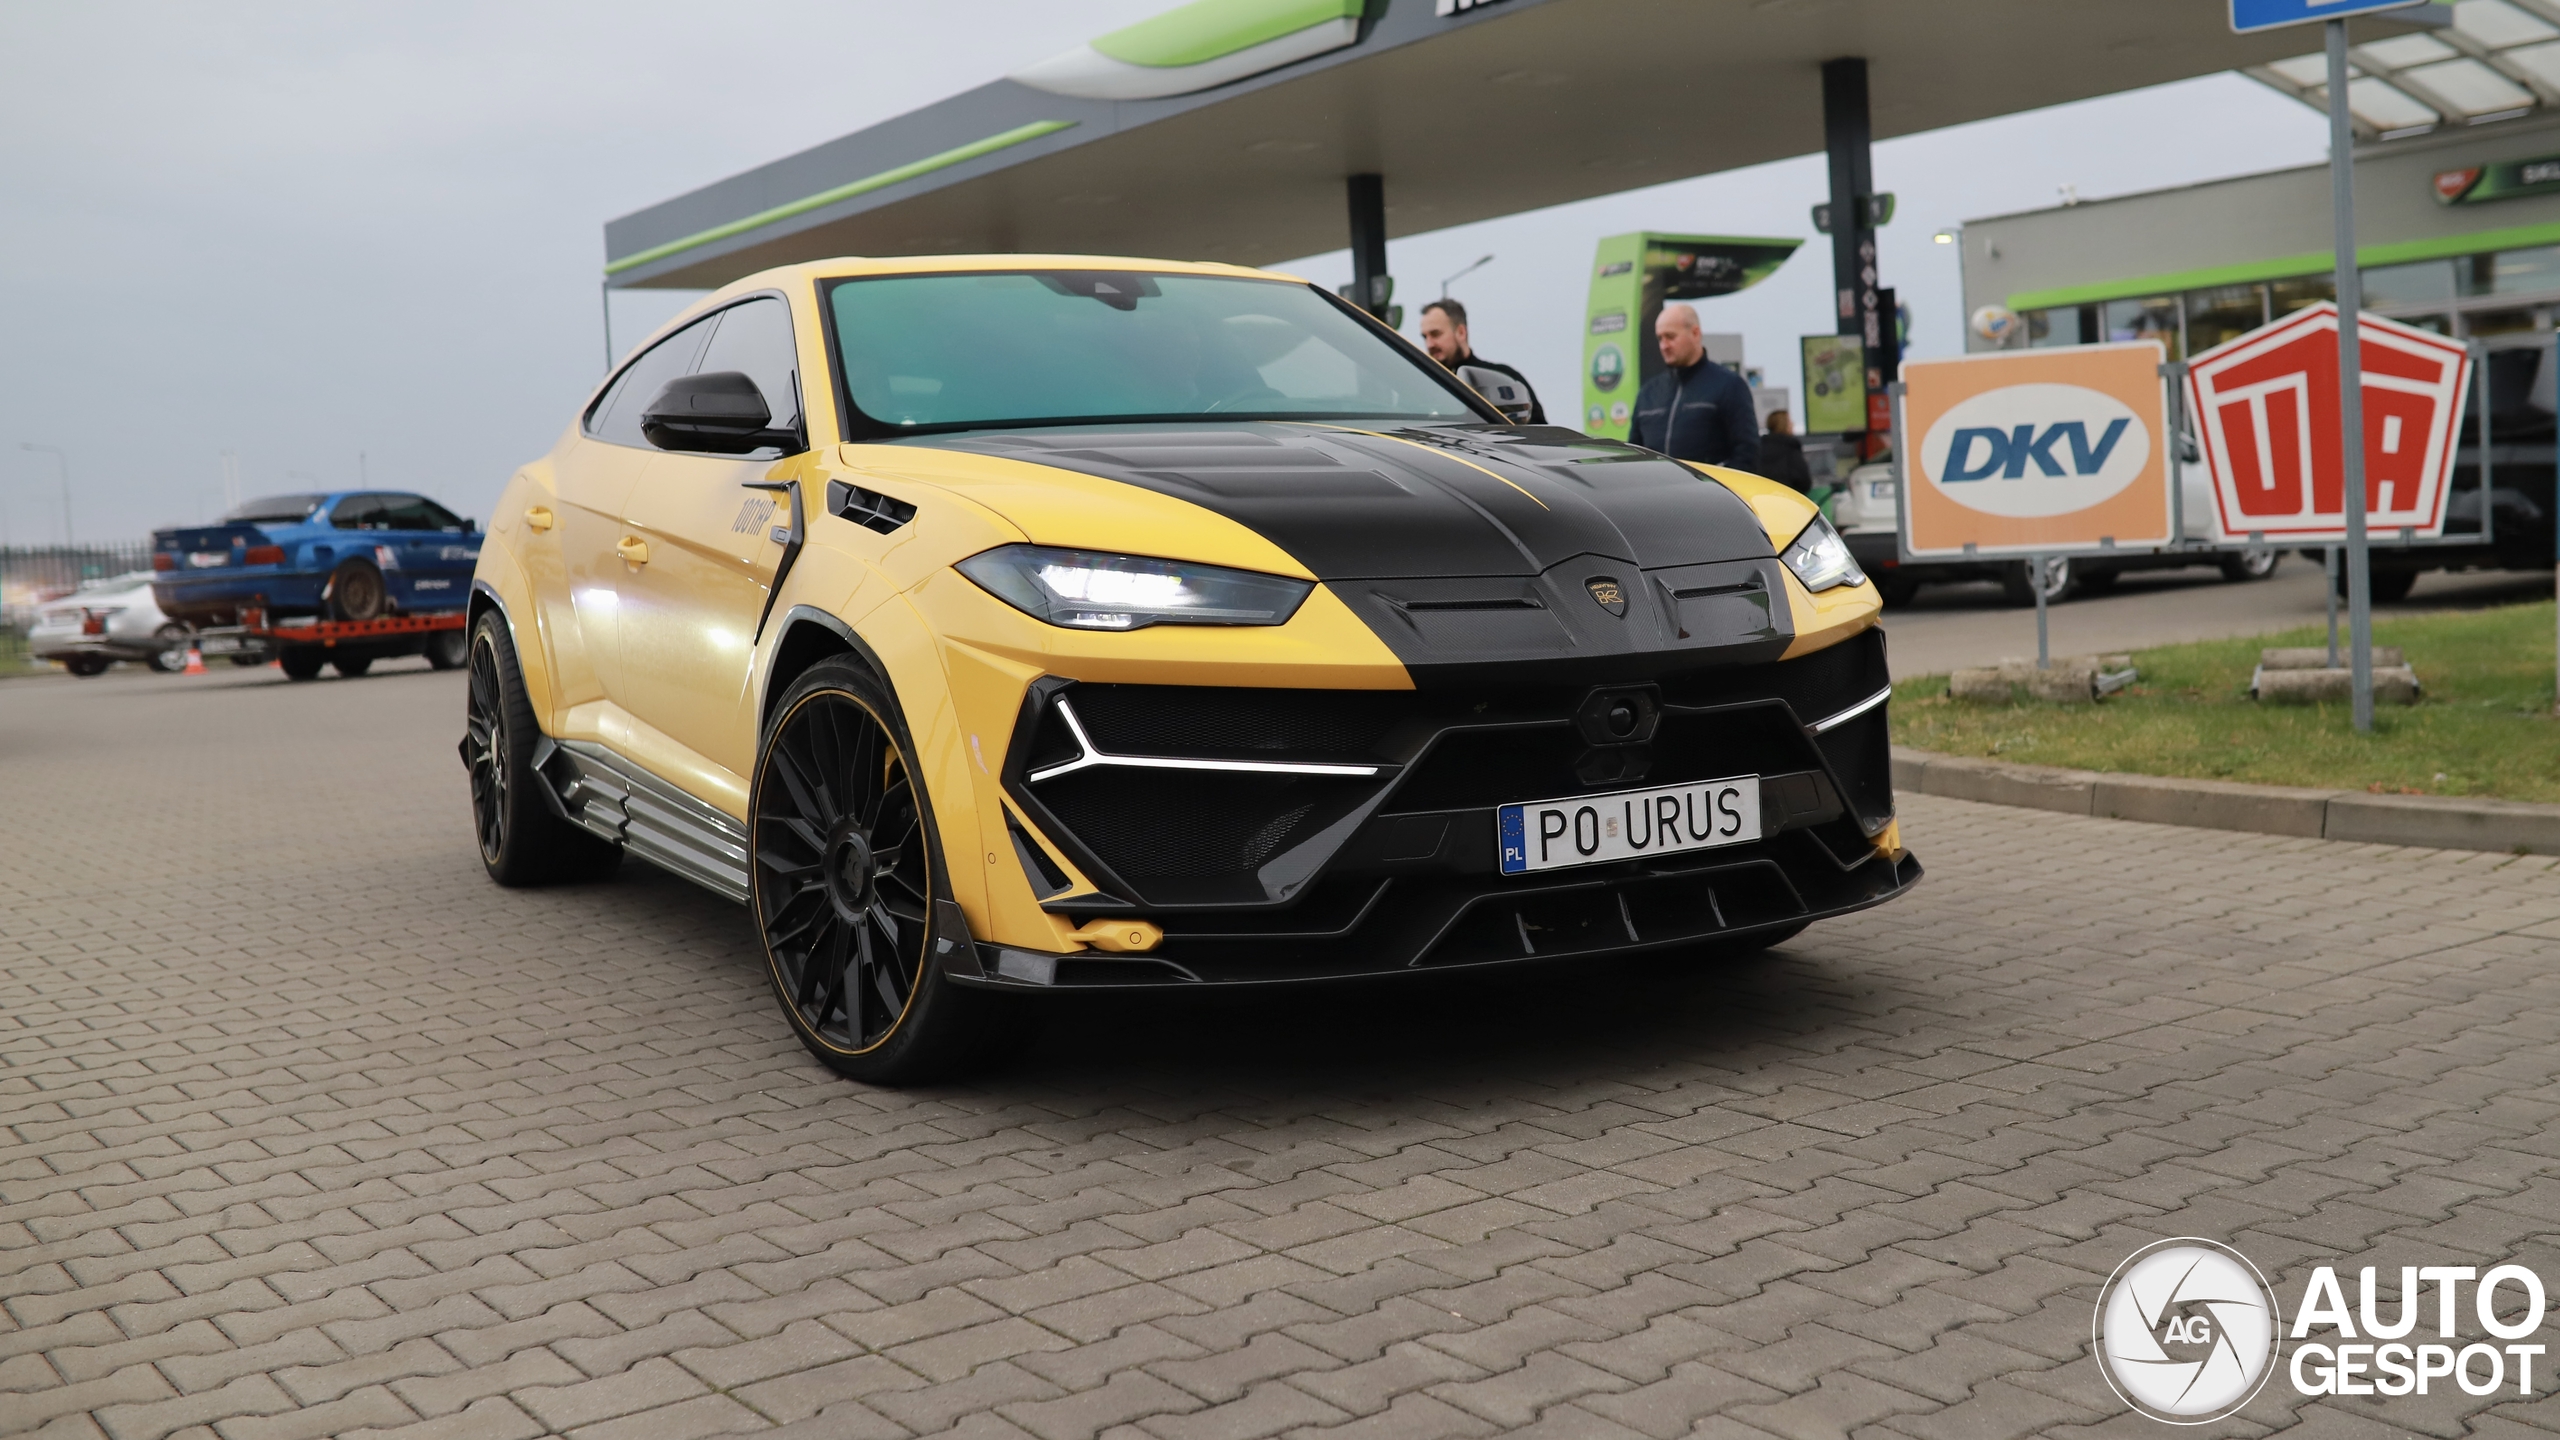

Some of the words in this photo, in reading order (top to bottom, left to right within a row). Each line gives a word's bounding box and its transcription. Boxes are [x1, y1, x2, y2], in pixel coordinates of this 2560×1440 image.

[1940, 417, 2132, 483] DKV
[731, 497, 776, 536] 1001HP
[1624, 787, 1742, 850] URUS
[1505, 847, 1523, 862] PL
